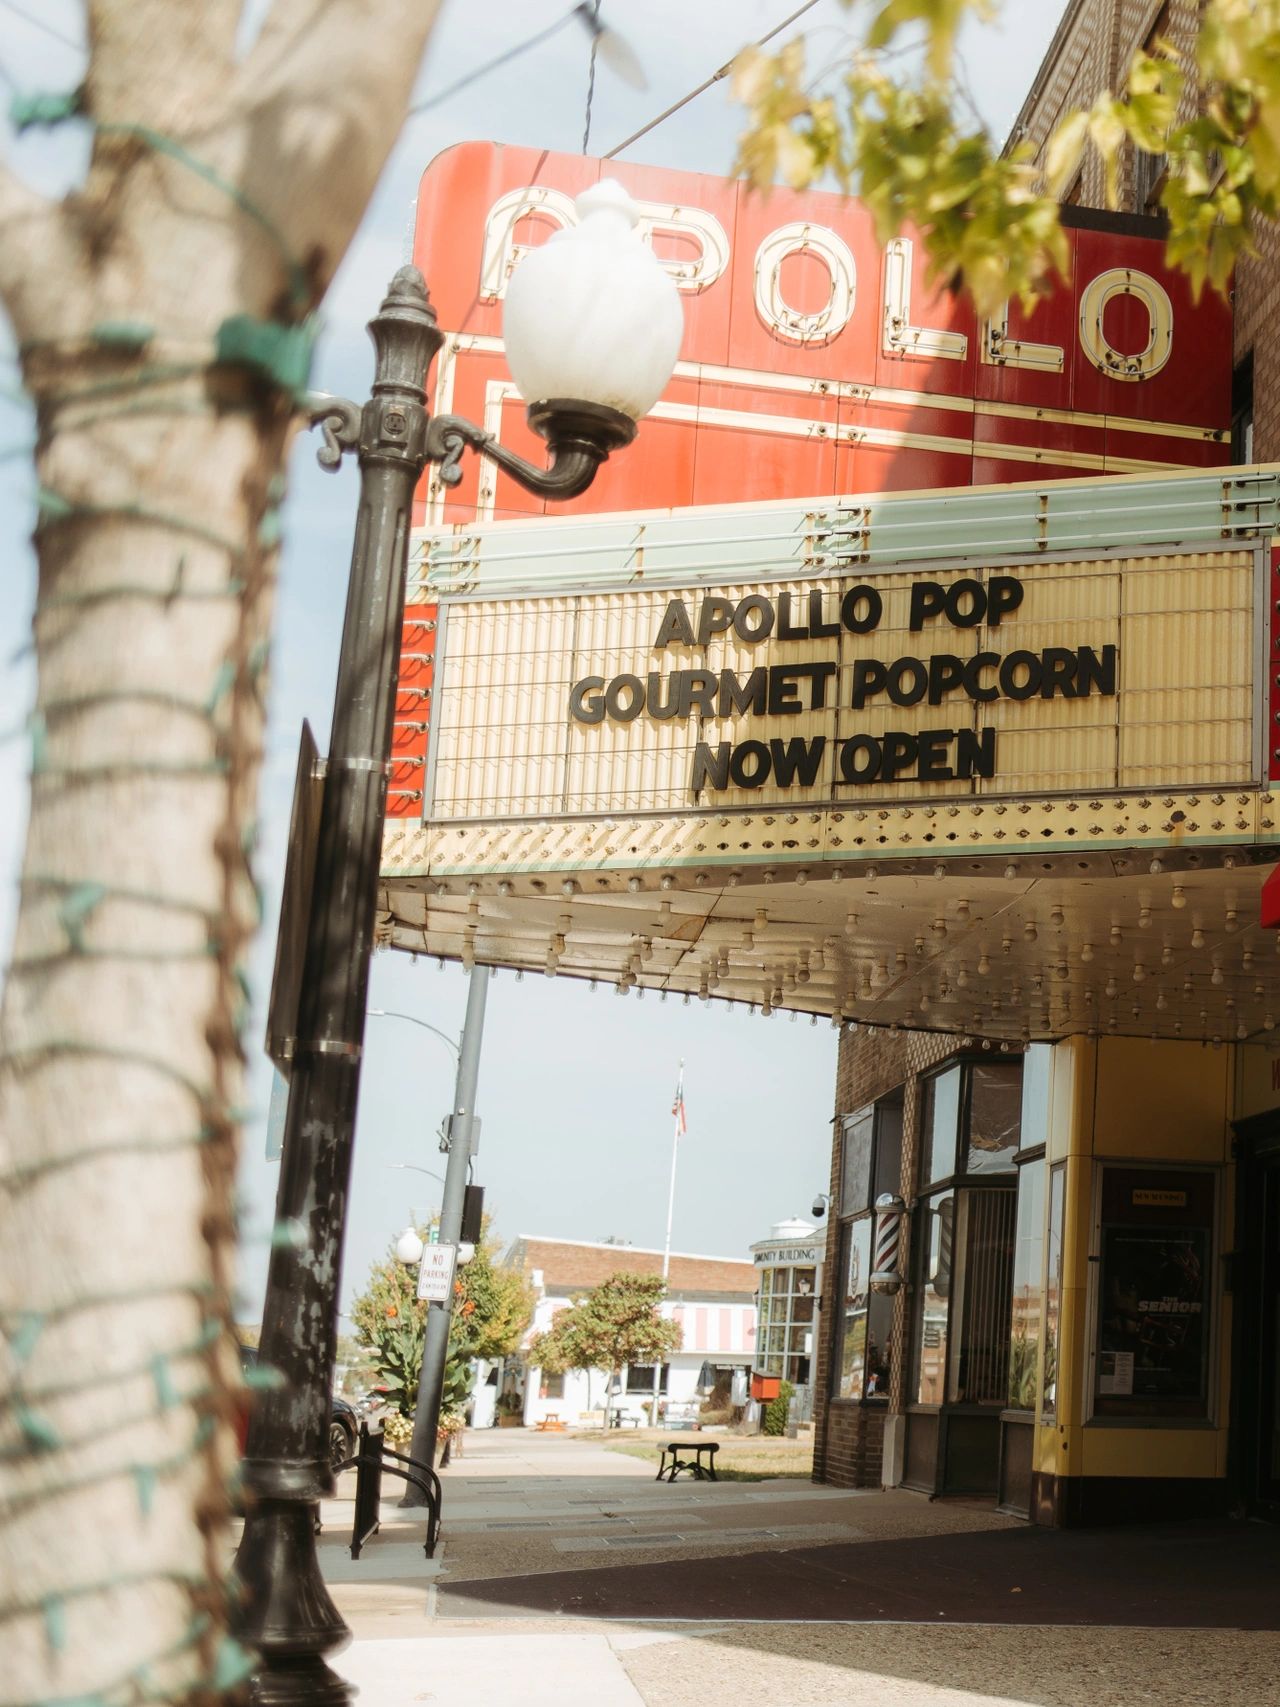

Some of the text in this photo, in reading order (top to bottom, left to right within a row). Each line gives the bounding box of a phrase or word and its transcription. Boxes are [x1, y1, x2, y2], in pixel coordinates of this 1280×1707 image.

[654, 575, 1025, 649] APOLLO POP
[568, 644, 1117, 725] GOURMET POPCORN
[691, 726, 996, 792] NOW OPEN
[433, 1255, 444, 1266] NO
[779, 1248, 815, 1261] BUILDING
[424, 1269, 449, 1280] PARKING
[1137, 1300, 1202, 1313] SENIOR
